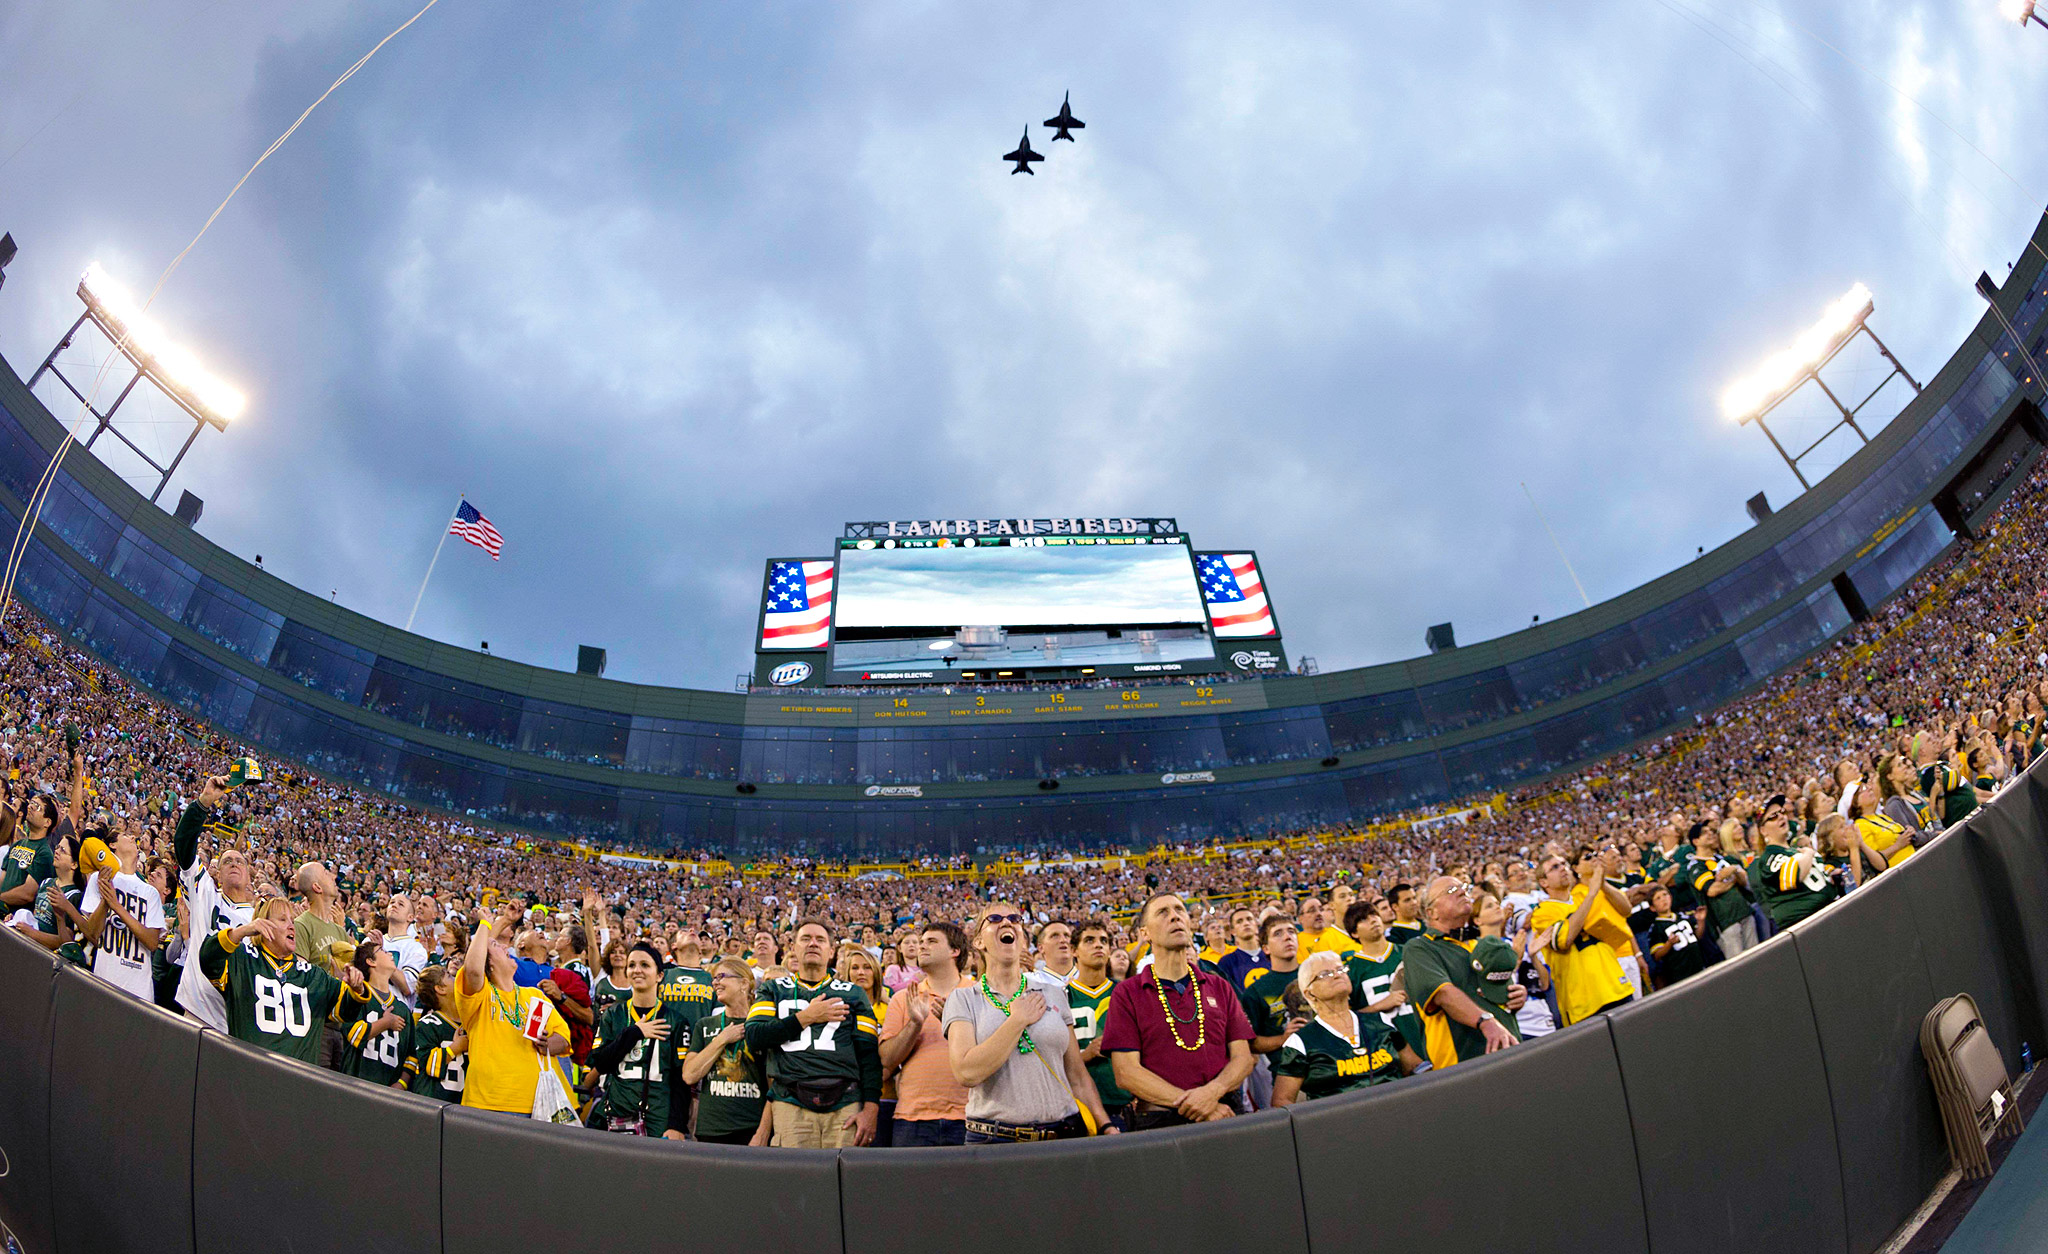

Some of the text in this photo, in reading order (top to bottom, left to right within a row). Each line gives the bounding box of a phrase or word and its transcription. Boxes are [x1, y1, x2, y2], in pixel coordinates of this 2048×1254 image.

[888, 517, 1138, 537] LAMBEAU FIELD
[1133, 663, 1182, 672] DIAMOND VISION
[904, 671, 933, 679] ELECTRIC
[1121, 690, 1140, 701] 66
[1196, 687, 1214, 698] 92
[893, 698, 909, 708] 14
[976, 696, 985, 706] 3
[1050, 693, 1066, 704] 15
[895, 710, 927, 718] HUTSON
[1058, 705, 1083, 713] STARR
[1664, 920, 1698, 951] 52
[659, 983, 714, 1000] PACKERS
[255, 974, 312, 1037] 80
[710, 1080, 761, 1099] PACKERS
